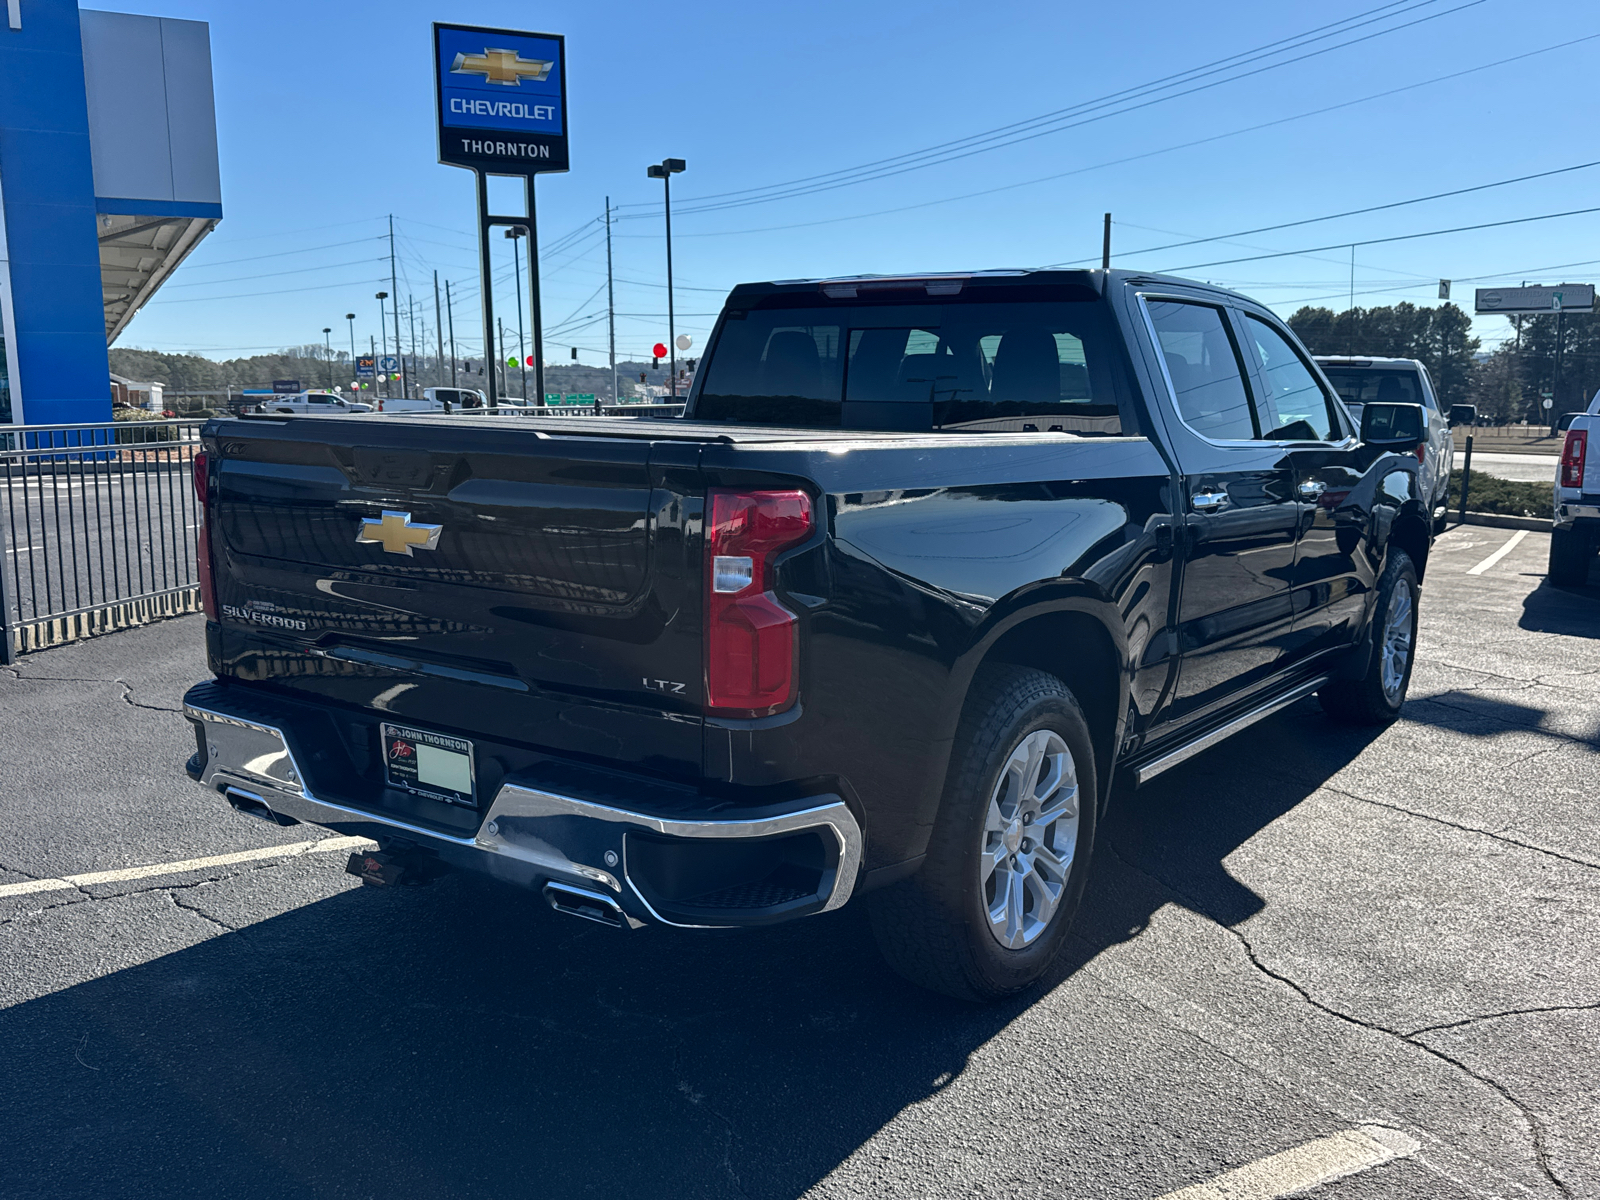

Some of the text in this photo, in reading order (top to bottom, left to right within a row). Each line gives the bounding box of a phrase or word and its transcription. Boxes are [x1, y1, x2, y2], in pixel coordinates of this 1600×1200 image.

[450, 98, 555, 120] CHEVROLET
[461, 139, 550, 158] THORNTON
[222, 604, 306, 631] SILVERADO
[642, 677, 687, 695] LTZ
[401, 729, 468, 751] JOHN THORNTON
